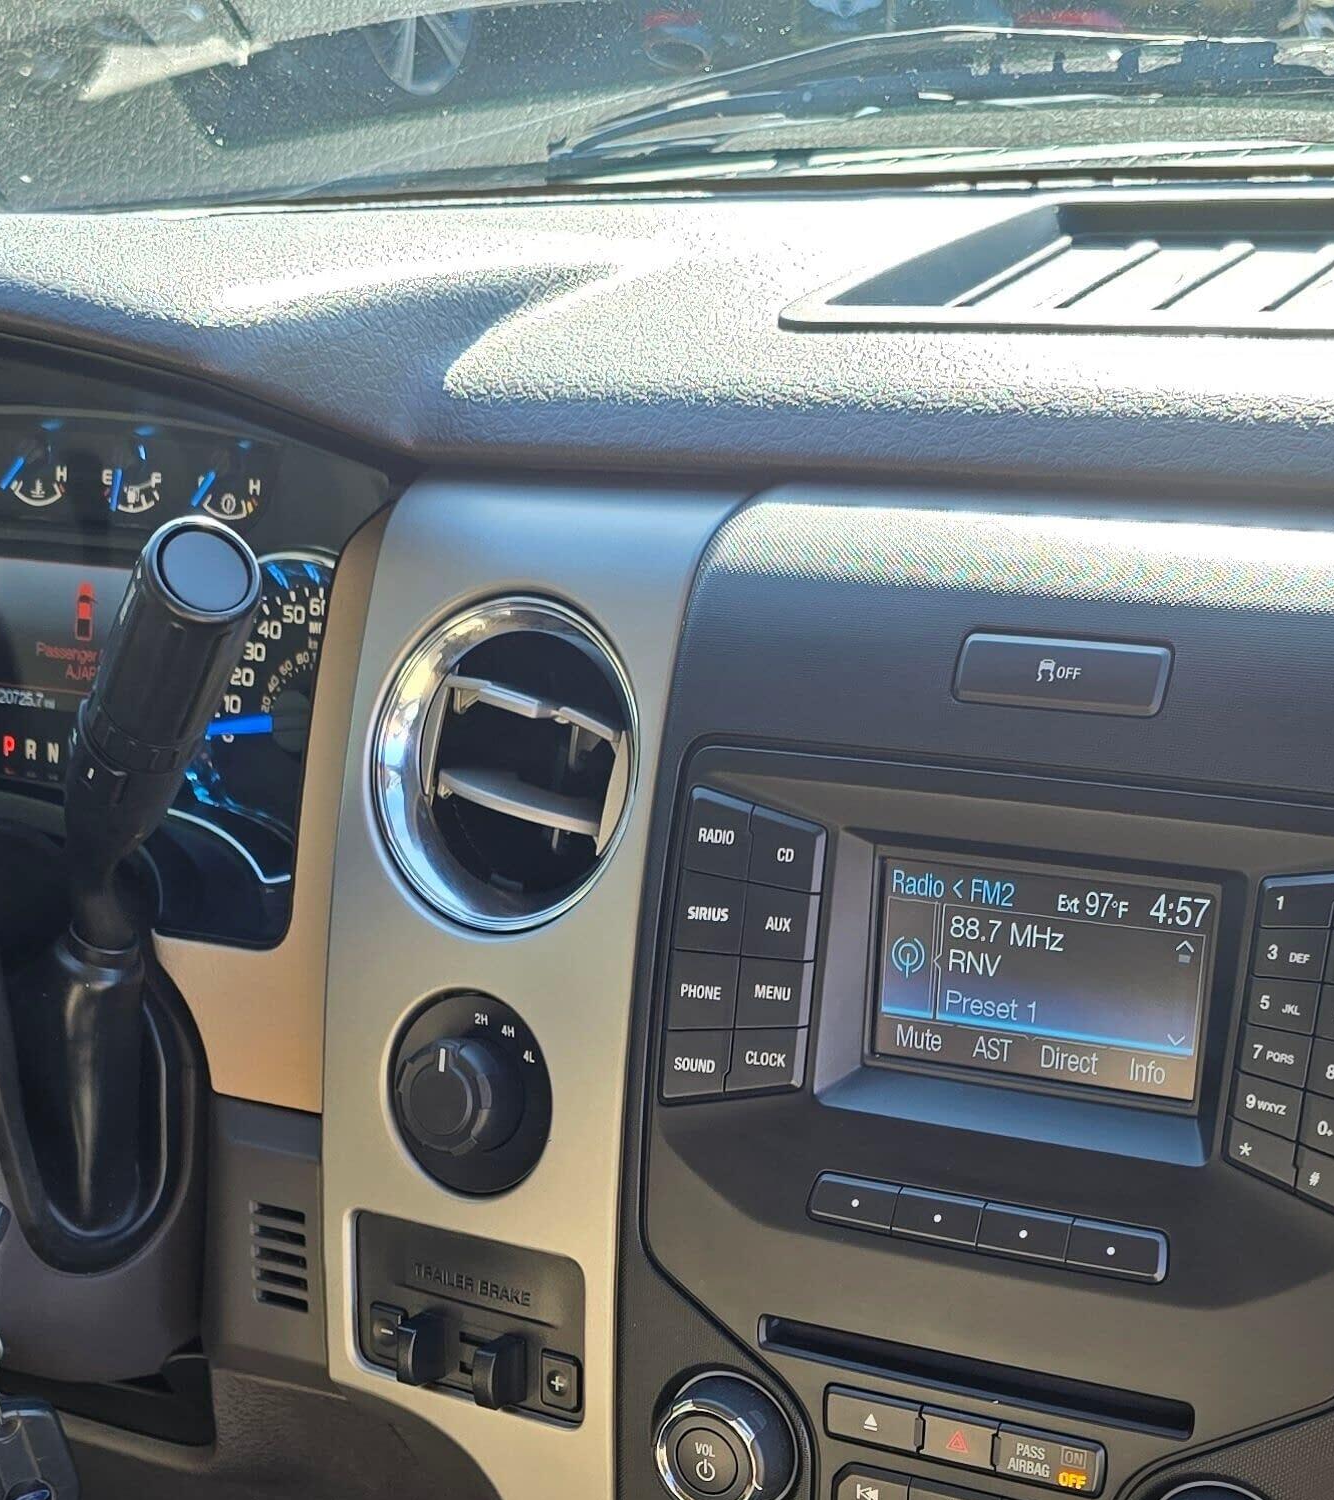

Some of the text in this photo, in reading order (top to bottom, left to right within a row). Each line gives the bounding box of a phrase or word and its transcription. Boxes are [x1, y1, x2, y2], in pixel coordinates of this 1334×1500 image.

[56, 466, 67, 482] H
[102, 470, 112, 486] E
[249, 478, 260, 495] H
[282, 604, 306, 624] 50
[257, 620, 282, 640] 40
[35, 641, 98, 664] Passenger
[243, 641, 266, 662] 30
[229, 667, 255, 687] 20
[1056, 666, 1082, 680] OFF
[223, 694, 242, 714] 10
[3, 735, 60, 764] P R N
[697, 827, 735, 846] RADIO
[776, 847, 795, 863] CD
[892, 869, 945, 899] Radio
[970, 878, 1016, 907] FM2
[1057, 893, 1079, 915] Ext
[1148, 893, 1212, 928] 4:57
[1275, 895, 1285, 910] 1
[687, 905, 730, 922] SIRIUS
[764, 915, 792, 933] AUX
[949, 915, 1065, 952] 88.7 MHz
[947, 948, 1002, 978] RNV
[1267, 944, 1311, 965] 3 DEF
[680, 983, 722, 1001] PHONE
[753, 983, 792, 1001] MENU
[945, 989, 1037, 1024] Preset 1
[1259, 994, 1301, 1017] 5 JKL
[474, 1012, 489, 1026] 2H
[500, 1023, 516, 1038] 4H
[896, 1024, 943, 1052] Mute
[523, 1050, 536, 1064] 4L
[744, 1050, 787, 1068] CLOCK
[972, 1035, 1013, 1063] AST
[1252, 1043, 1295, 1066] 7 PQRS
[673, 1056, 716, 1074] SOUND
[1039, 1044, 1099, 1076] Direct
[1129, 1058, 1166, 1085] Info
[1245, 1093, 1288, 1116] 9 WXYZ
[412, 1262, 531, 1307] TRAILER BRAKE
[694, 1441, 716, 1458] VOL
[1016, 1442, 1046, 1461] PASS
[1064, 1450, 1084, 1466] ON
[1007, 1457, 1051, 1478] AIRBAG
[1057, 1471, 1088, 1490] OFF
